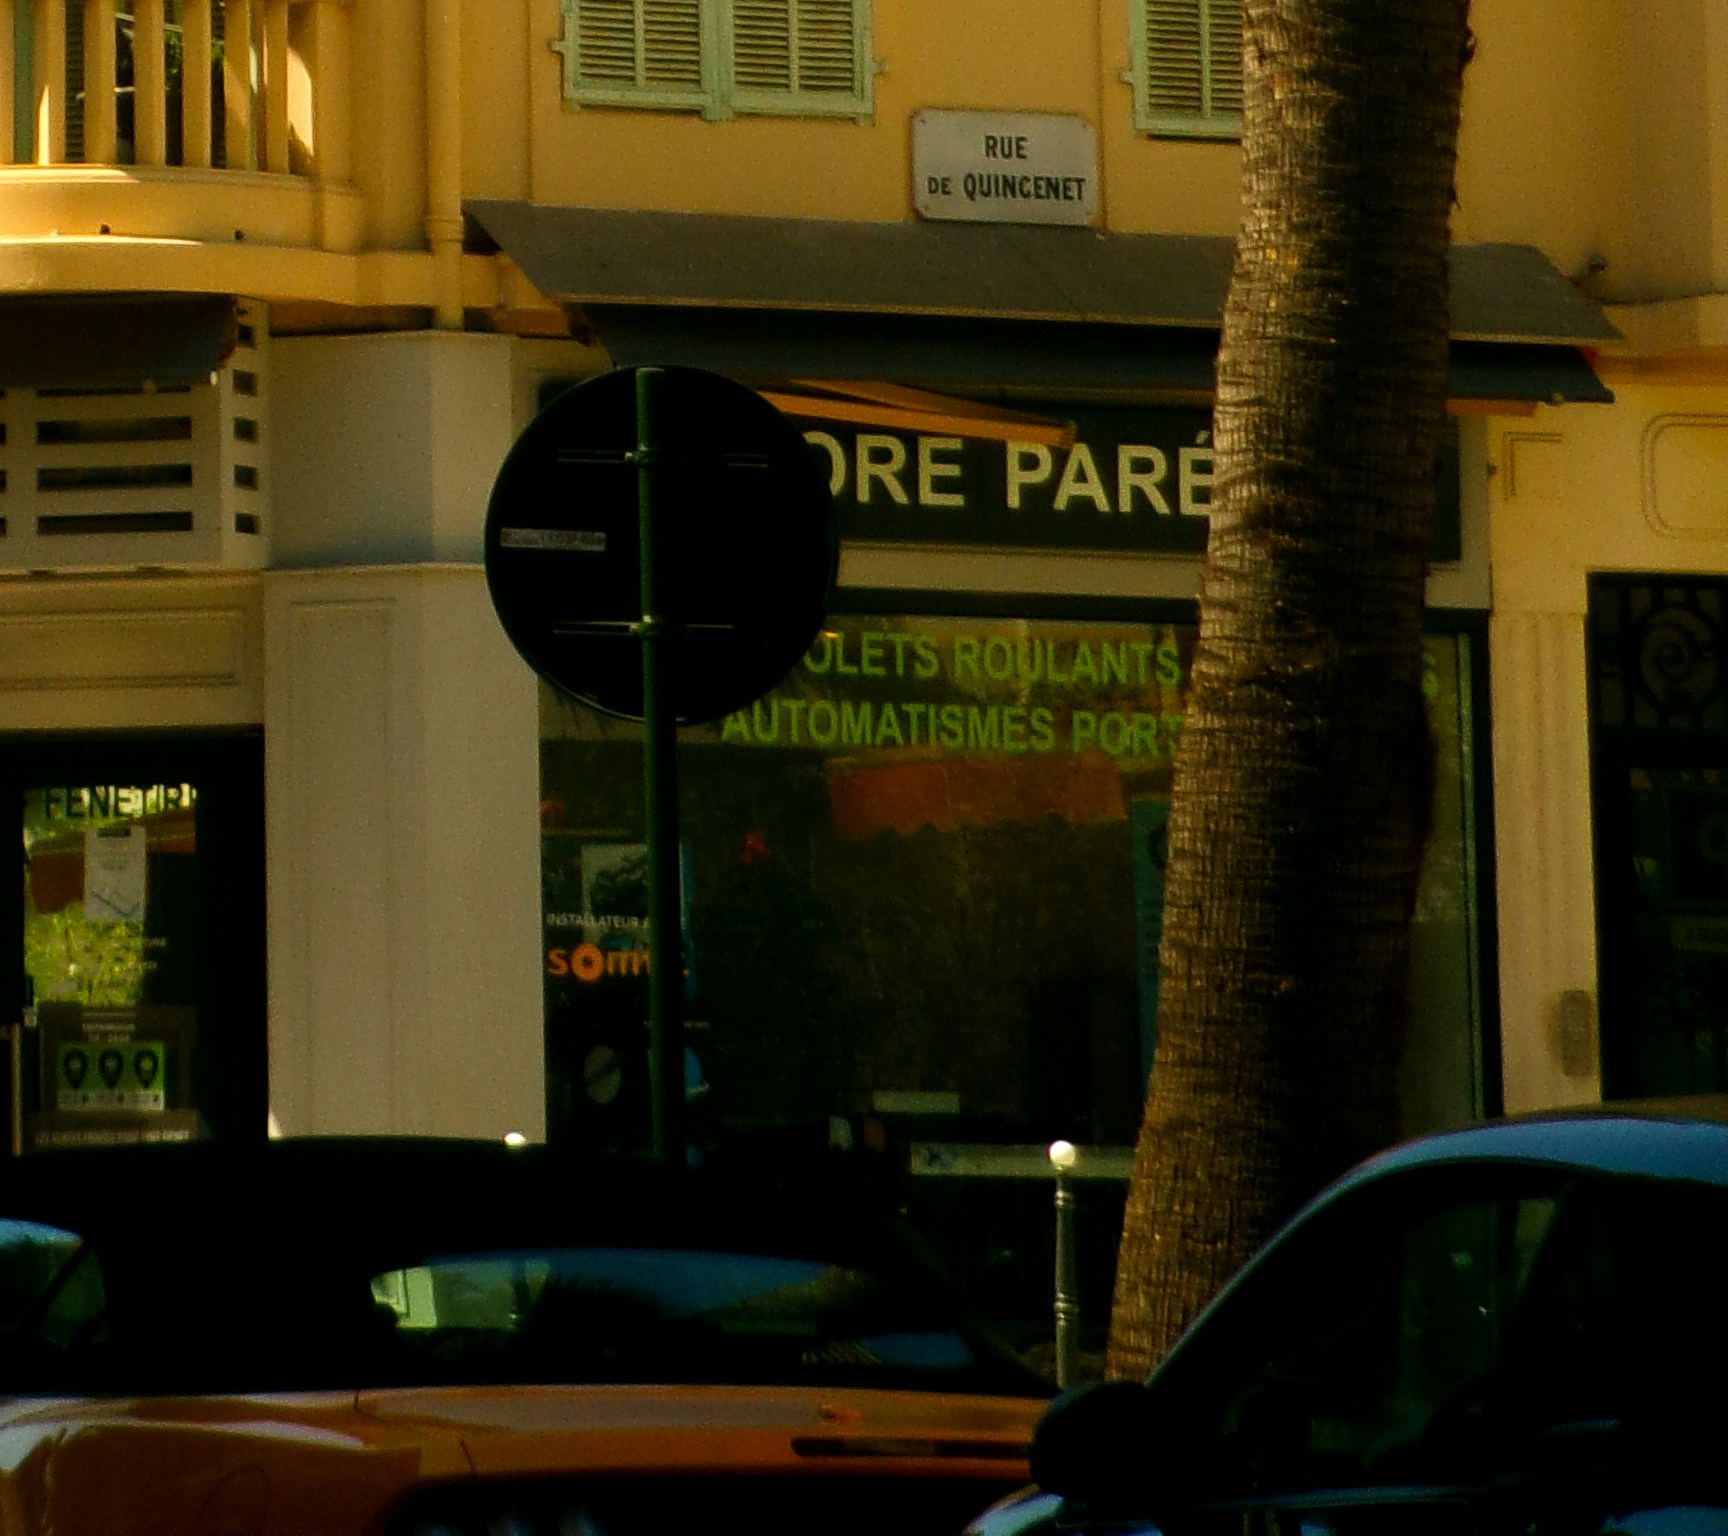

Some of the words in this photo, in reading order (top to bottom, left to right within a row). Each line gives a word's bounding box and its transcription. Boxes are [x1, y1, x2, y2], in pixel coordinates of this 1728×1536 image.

[984, 134, 1028, 160] RUE
[926, 175, 952, 196] DE
[963, 172, 1087, 202] QUINCENET
[800, 429, 966, 507] ORE
[1005, 429, 1215, 518] PARÉ
[803, 631, 941, 678] OLETS
[953, 634, 1183, 687] ROULANTS
[720, 698, 1056, 753] AUTOMATISMES
[1071, 707, 1185, 758] PORT
